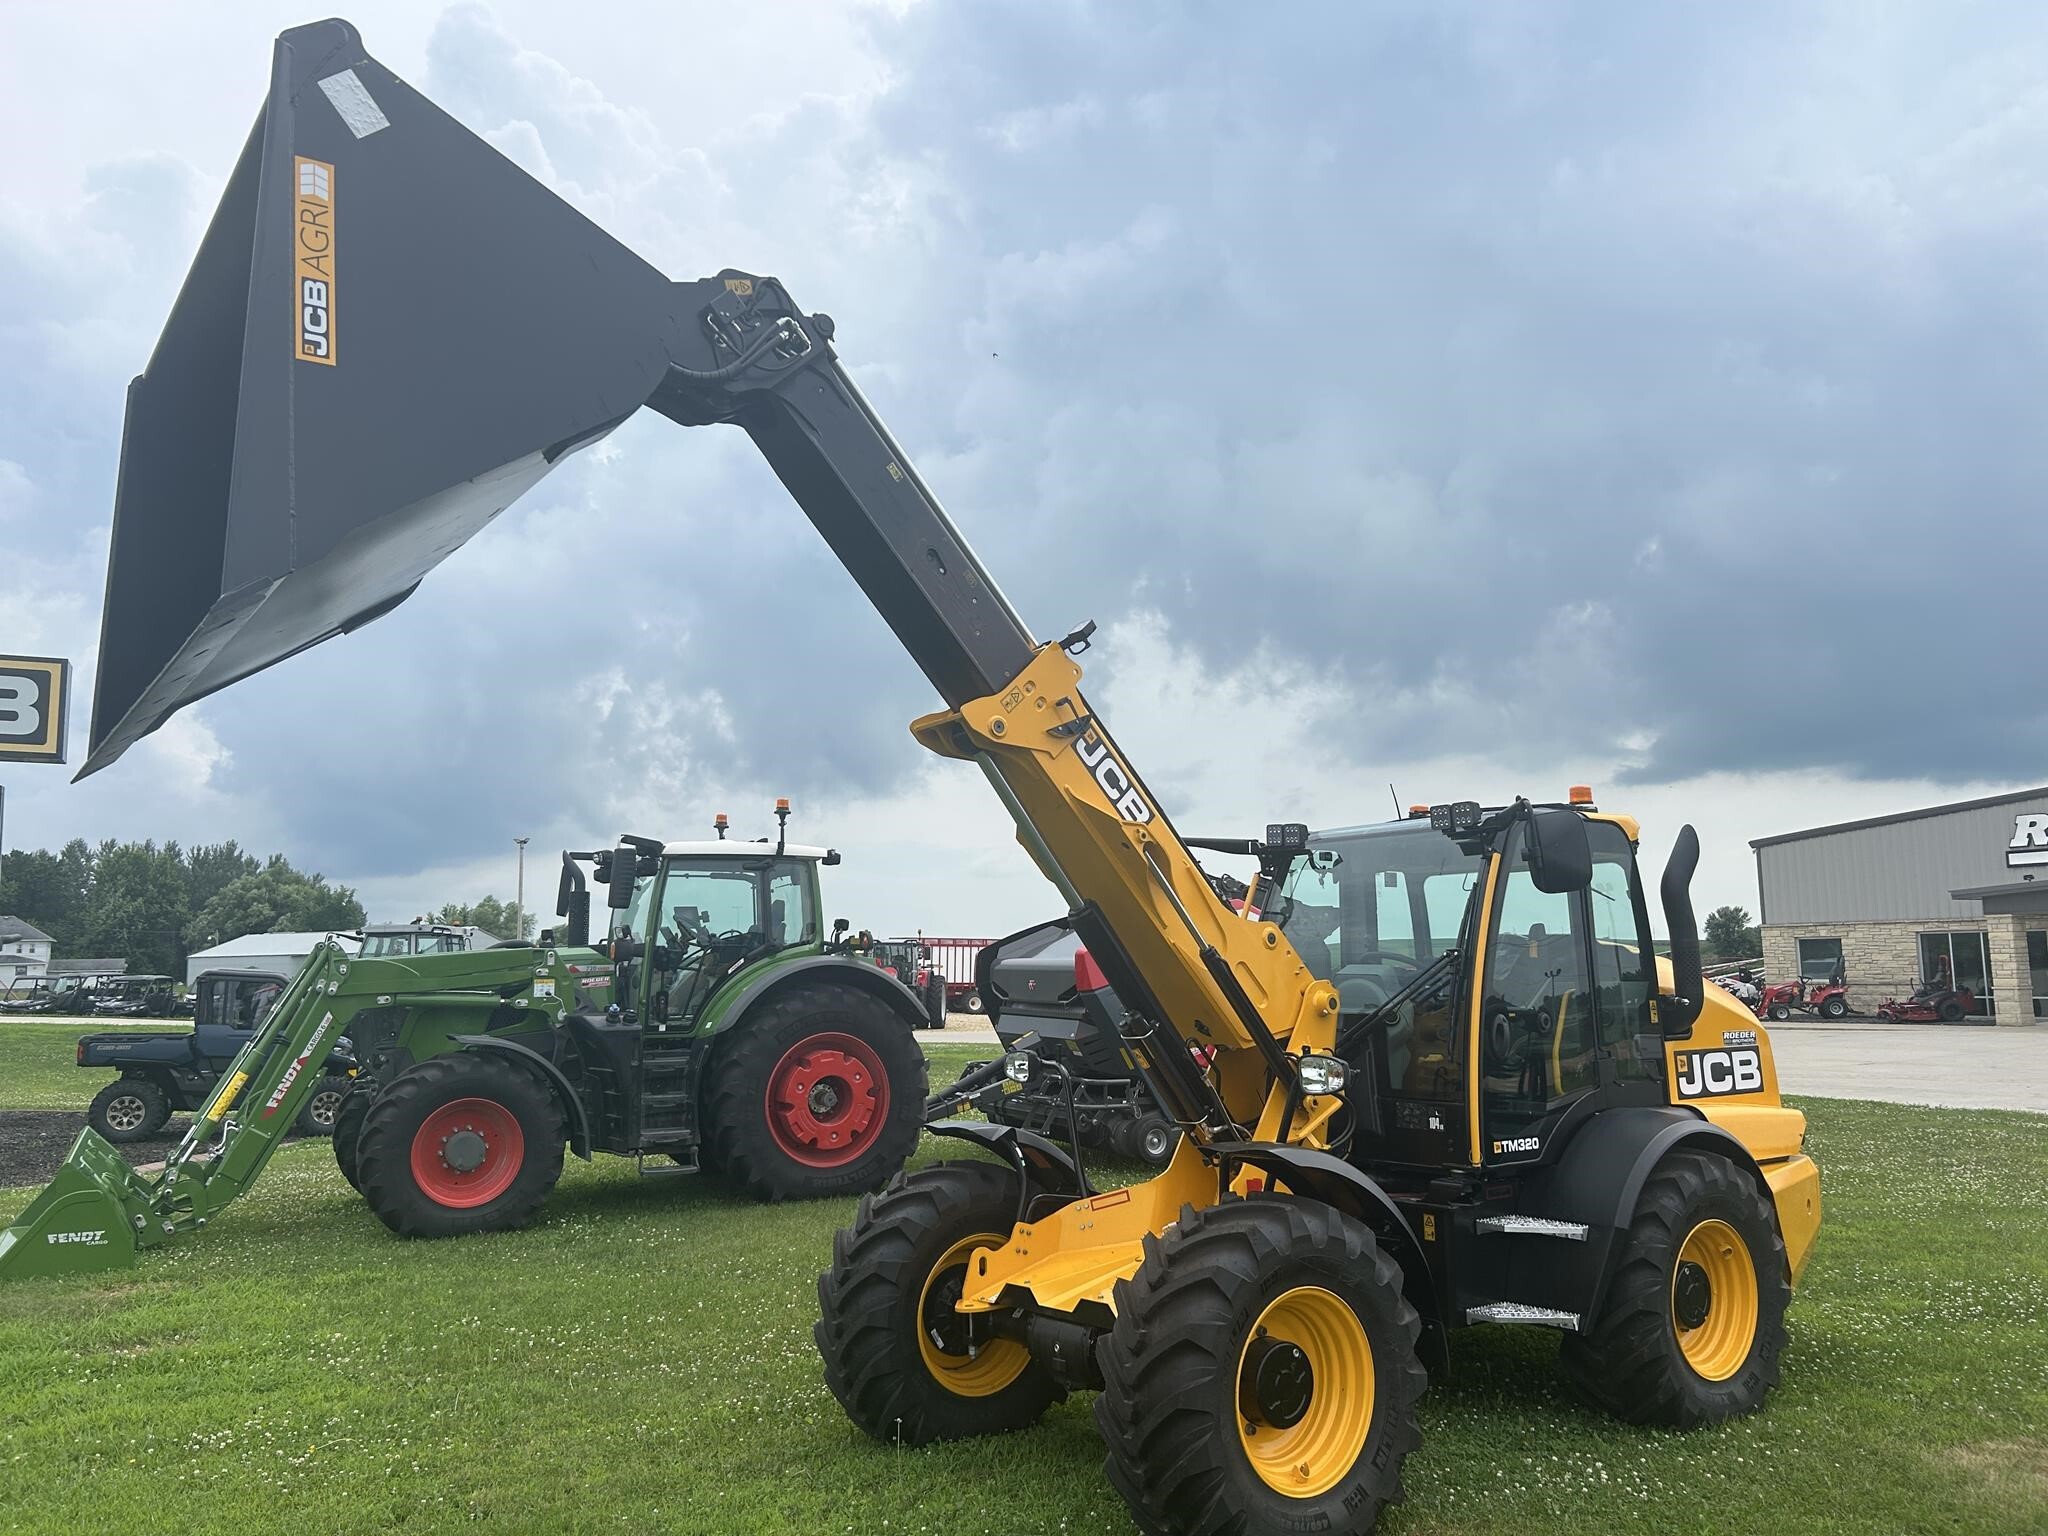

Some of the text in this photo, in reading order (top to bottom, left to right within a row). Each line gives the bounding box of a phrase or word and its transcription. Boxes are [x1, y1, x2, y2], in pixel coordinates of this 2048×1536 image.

[300, 199, 330, 357] JCB AGRI
[1076, 738, 1151, 822] JCB
[306, 1029, 323, 1052] CARGO
[1723, 1031, 1756, 1040] ROEDER
[266, 1058, 303, 1109] FENDT
[1679, 1050, 1761, 1096] JCB
[1501, 1137, 1540, 1153] TM320
[47, 1230, 106, 1244] FENDT
